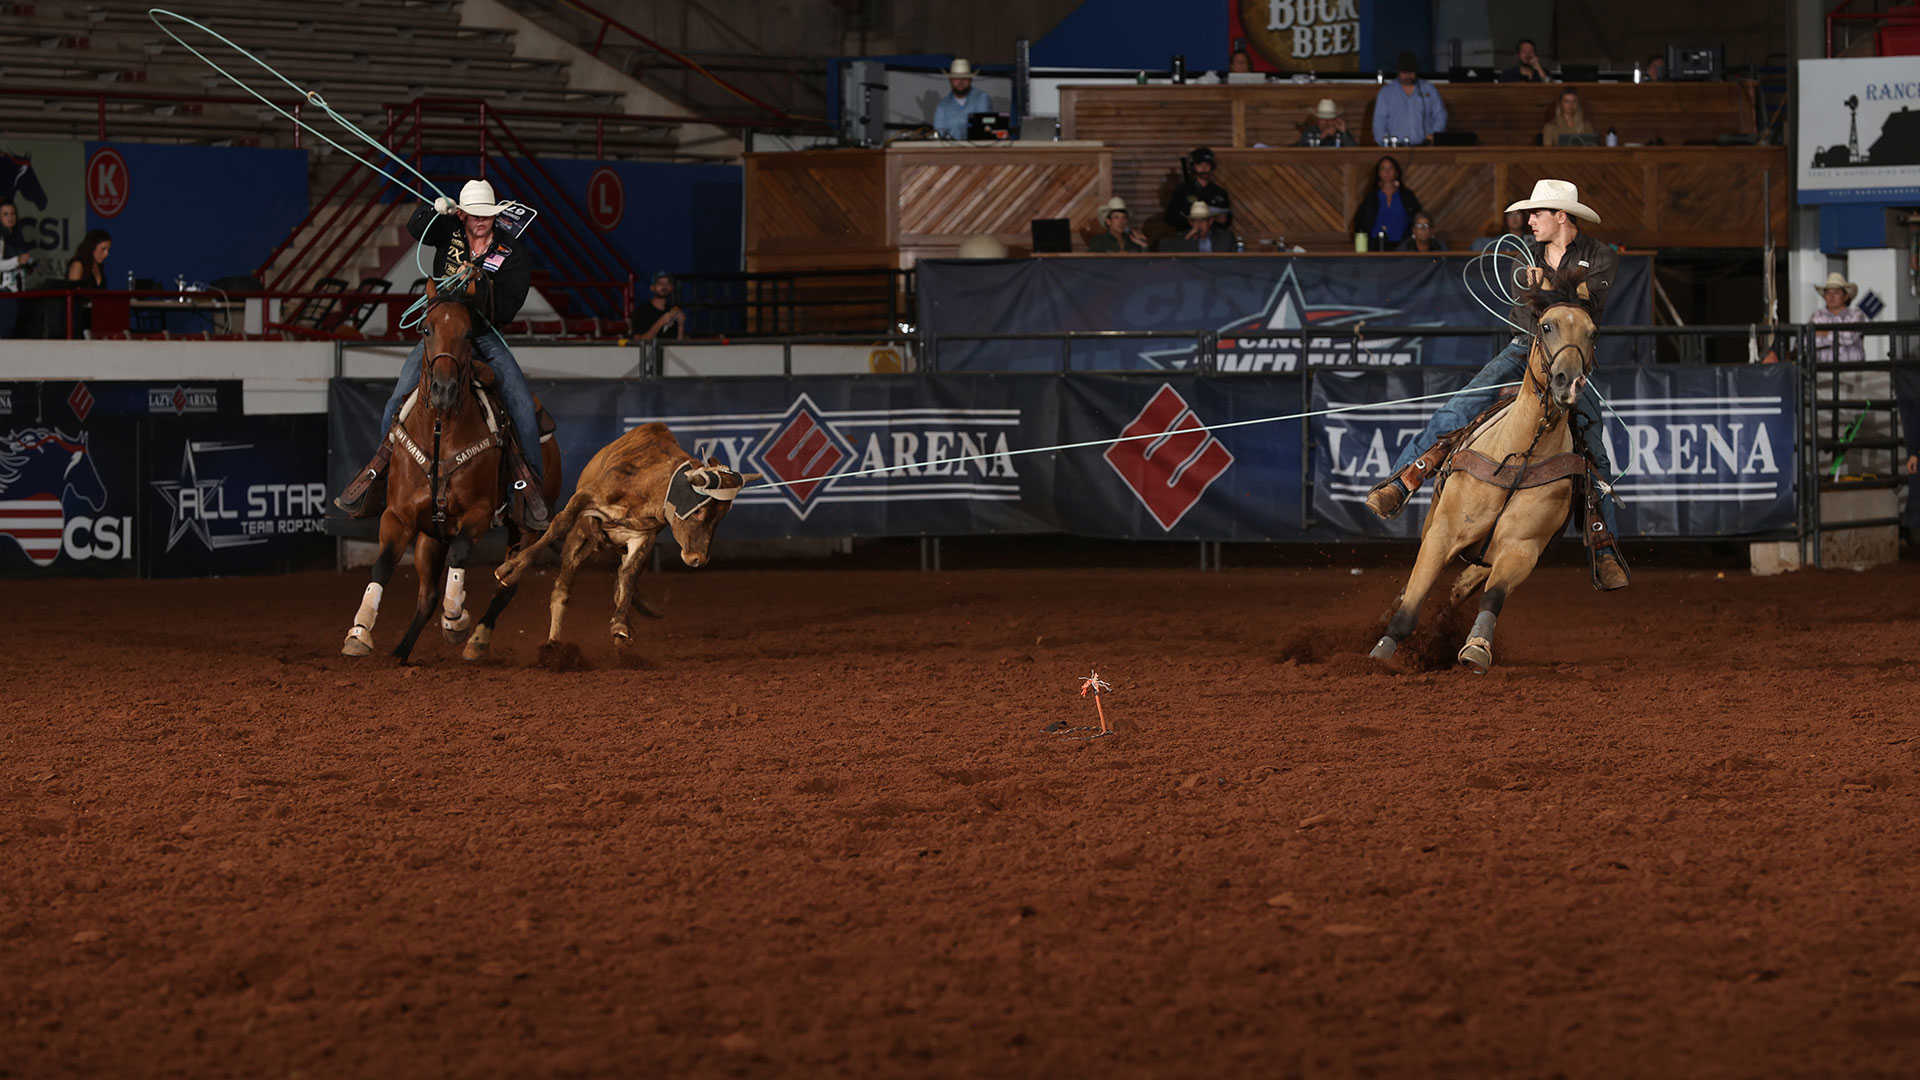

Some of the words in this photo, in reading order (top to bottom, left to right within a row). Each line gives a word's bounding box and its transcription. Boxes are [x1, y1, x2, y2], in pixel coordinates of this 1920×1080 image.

[98, 164, 119, 195] K
[600, 184, 613, 213] L
[149, 394, 171, 407] LAZY
[189, 394, 217, 407] ARENA
[856, 431, 1019, 479] ARENA
[179, 486, 238, 520] ALL
[247, 483, 326, 518] STAR
[63, 515, 133, 561] CSI
[240, 520, 274, 535] TEAM
